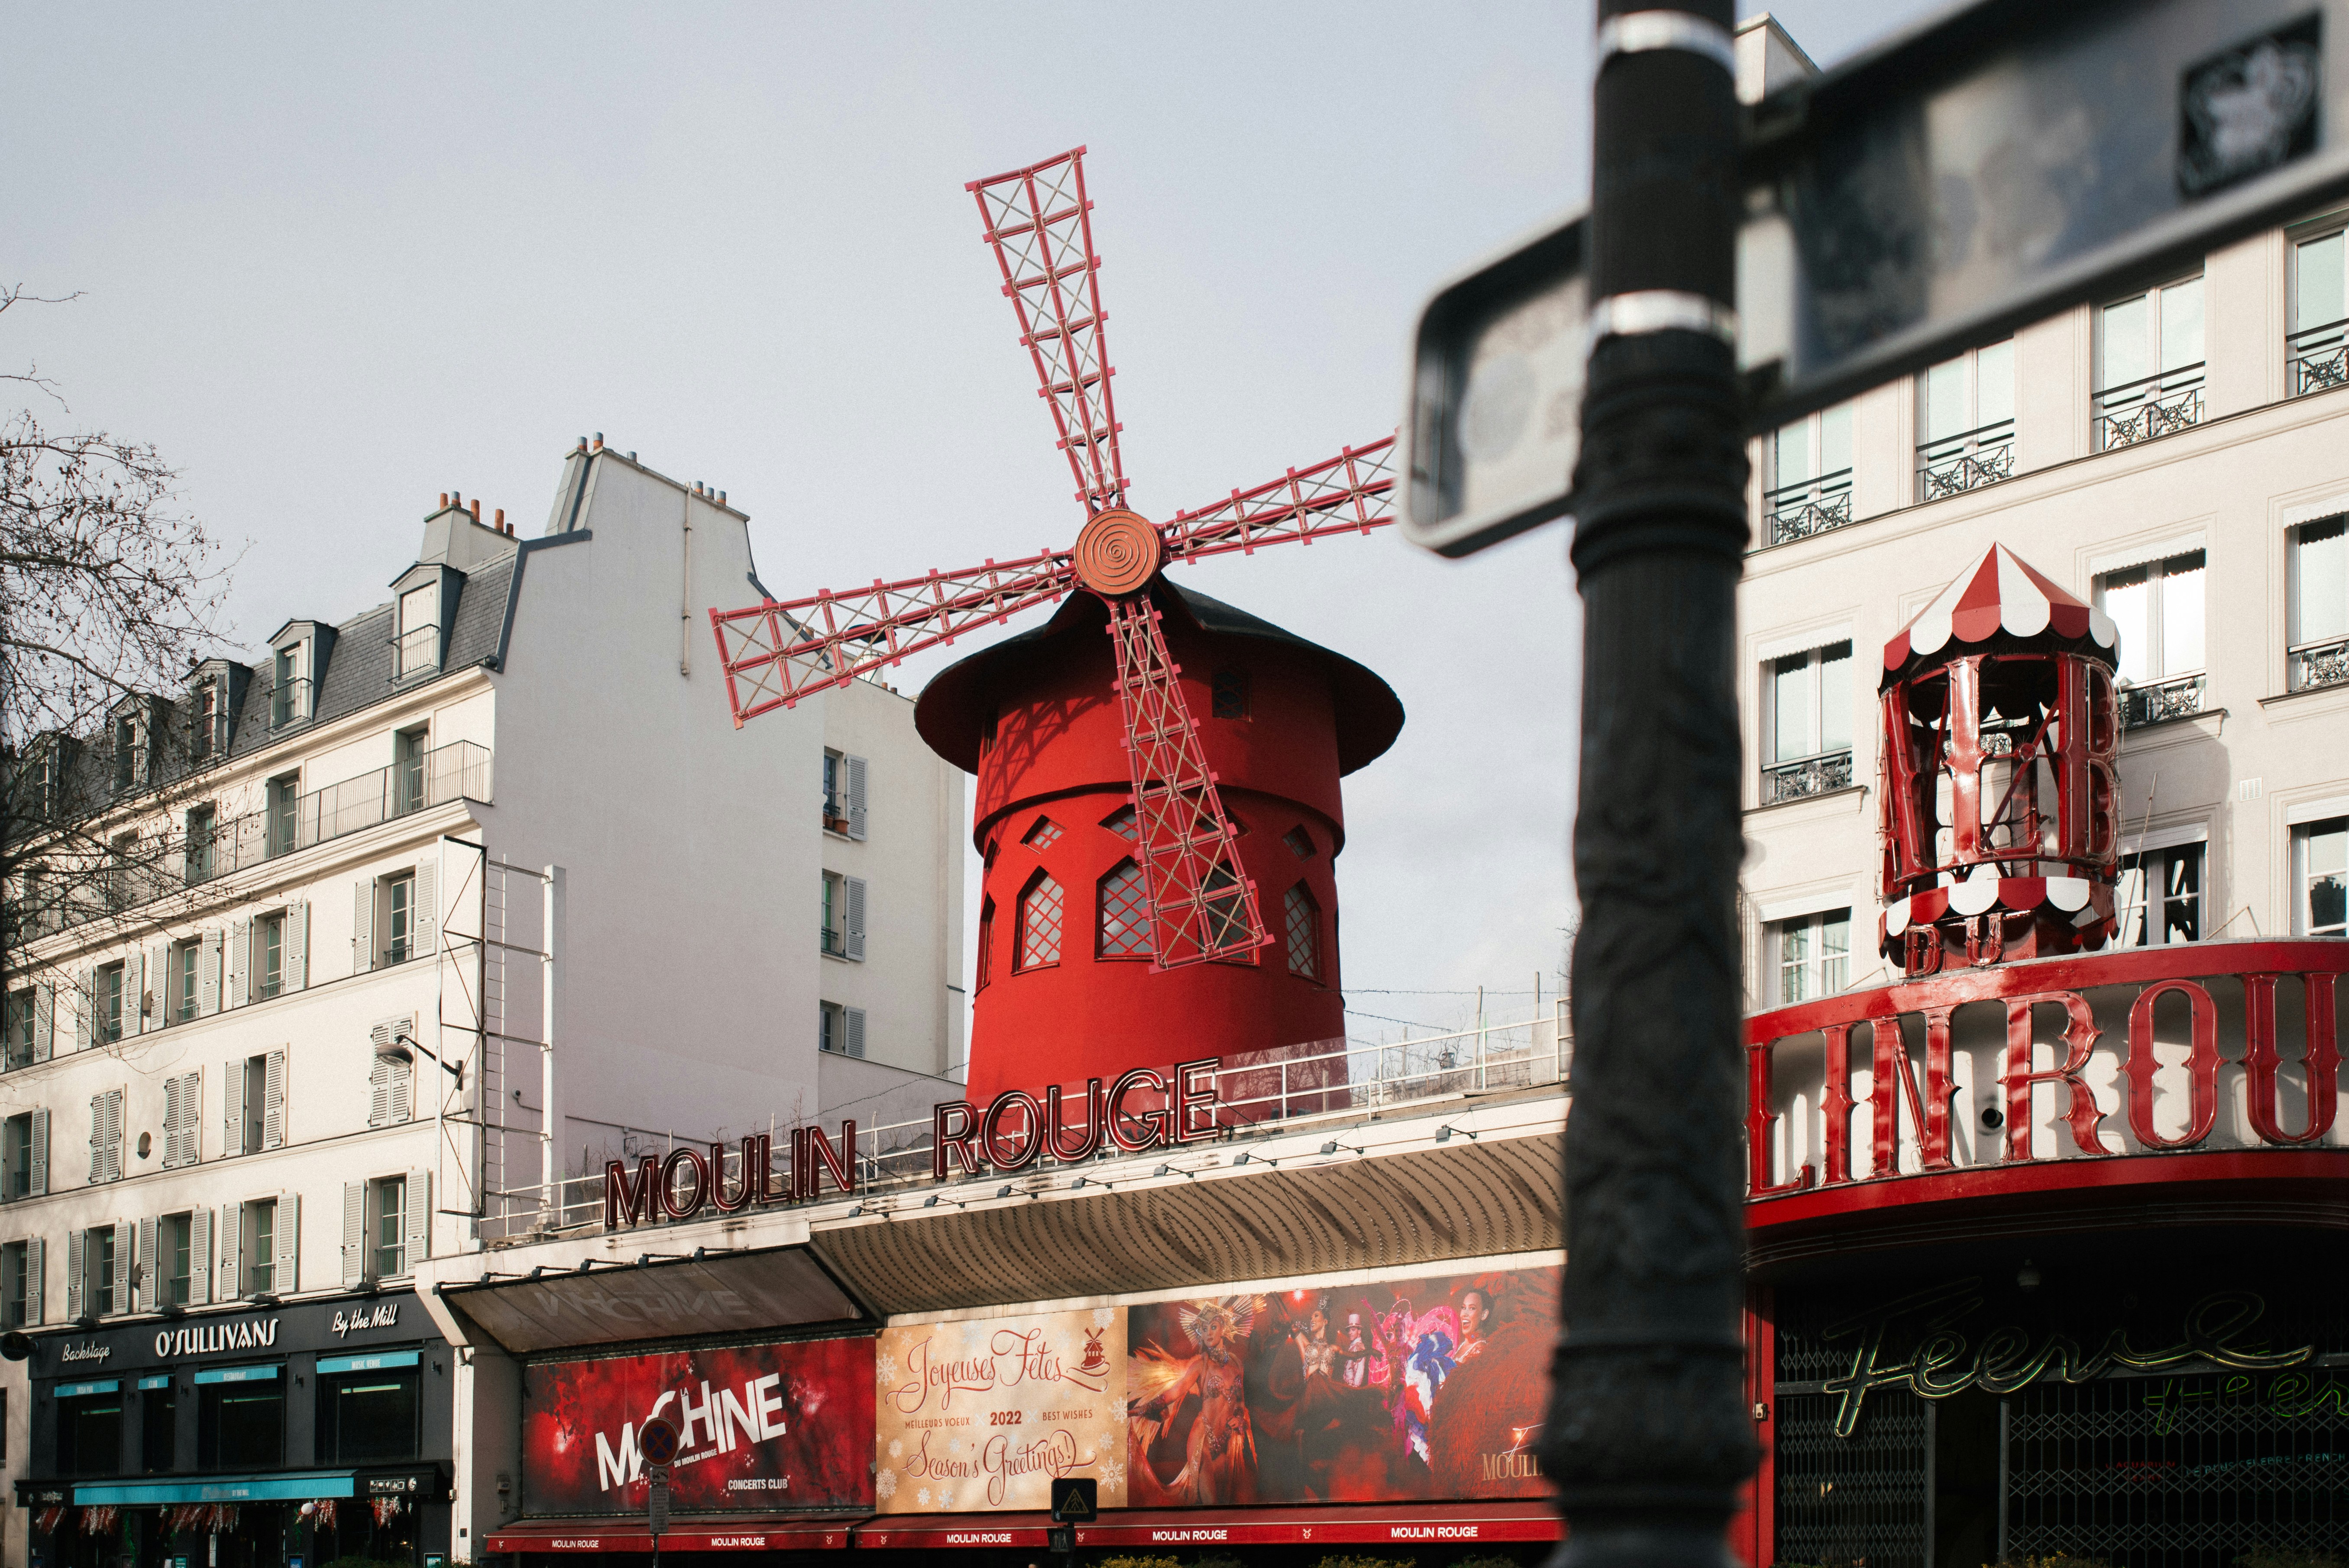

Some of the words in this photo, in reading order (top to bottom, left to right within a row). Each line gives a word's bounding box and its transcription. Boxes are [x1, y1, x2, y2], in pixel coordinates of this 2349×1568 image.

[1904, 915, 2005, 979] DU
[604, 1120, 856, 1228] MOULIN
[933, 1057, 1221, 1181] ROUGE
[332, 1311, 349, 1338] By
[350, 1307, 369, 1330] the
[370, 1303, 397, 1328] Mill
[155, 1318, 279, 1357] O'SULLIVANS
[62, 1341, 110, 1364] Backstage
[351, 1360, 365, 1369] MUSIC
[366, 1359, 380, 1368] VENUE
[886, 1336, 996, 1413] Joyeuses
[991, 1328, 1108, 1392] Fêtes
[223, 1371, 246, 1381] RESTAURANT
[681, 1387, 689, 1397] LA
[945, 1416, 970, 1427] VOEUX
[990, 1410, 1022, 1426] 2022
[1043, 1411, 1061, 1421] BEST
[1063, 1409, 1093, 1419] WISHES
[674, 1460, 681, 1468] DU
[682, 1453, 700, 1465] MOULIN
[701, 1449, 717, 1460] ROUGE
[1482, 1453, 1543, 1481] MOULI
[902, 1430, 979, 1481] Season's
[984, 1429, 1097, 1507] Greetings!
[728, 1479, 766, 1490] CONCERTS
[768, 1479, 787, 1489] CLUB
[947, 1534, 980, 1544] MOULIN
[982, 1533, 1011, 1542] ROUGE
[1152, 1530, 1190, 1541] MOULIN
[1192, 1529, 1227, 1539] ROUGE
[1391, 1527, 1435, 1538] MOULIN
[1437, 1526, 1478, 1537] ROUGE
[552, 1539, 576, 1549] MOULIN
[577, 1539, 599, 1548] ROUGE
[711, 1538, 738, 1547] MOULIN
[740, 1537, 765, 1546] ROUGE
